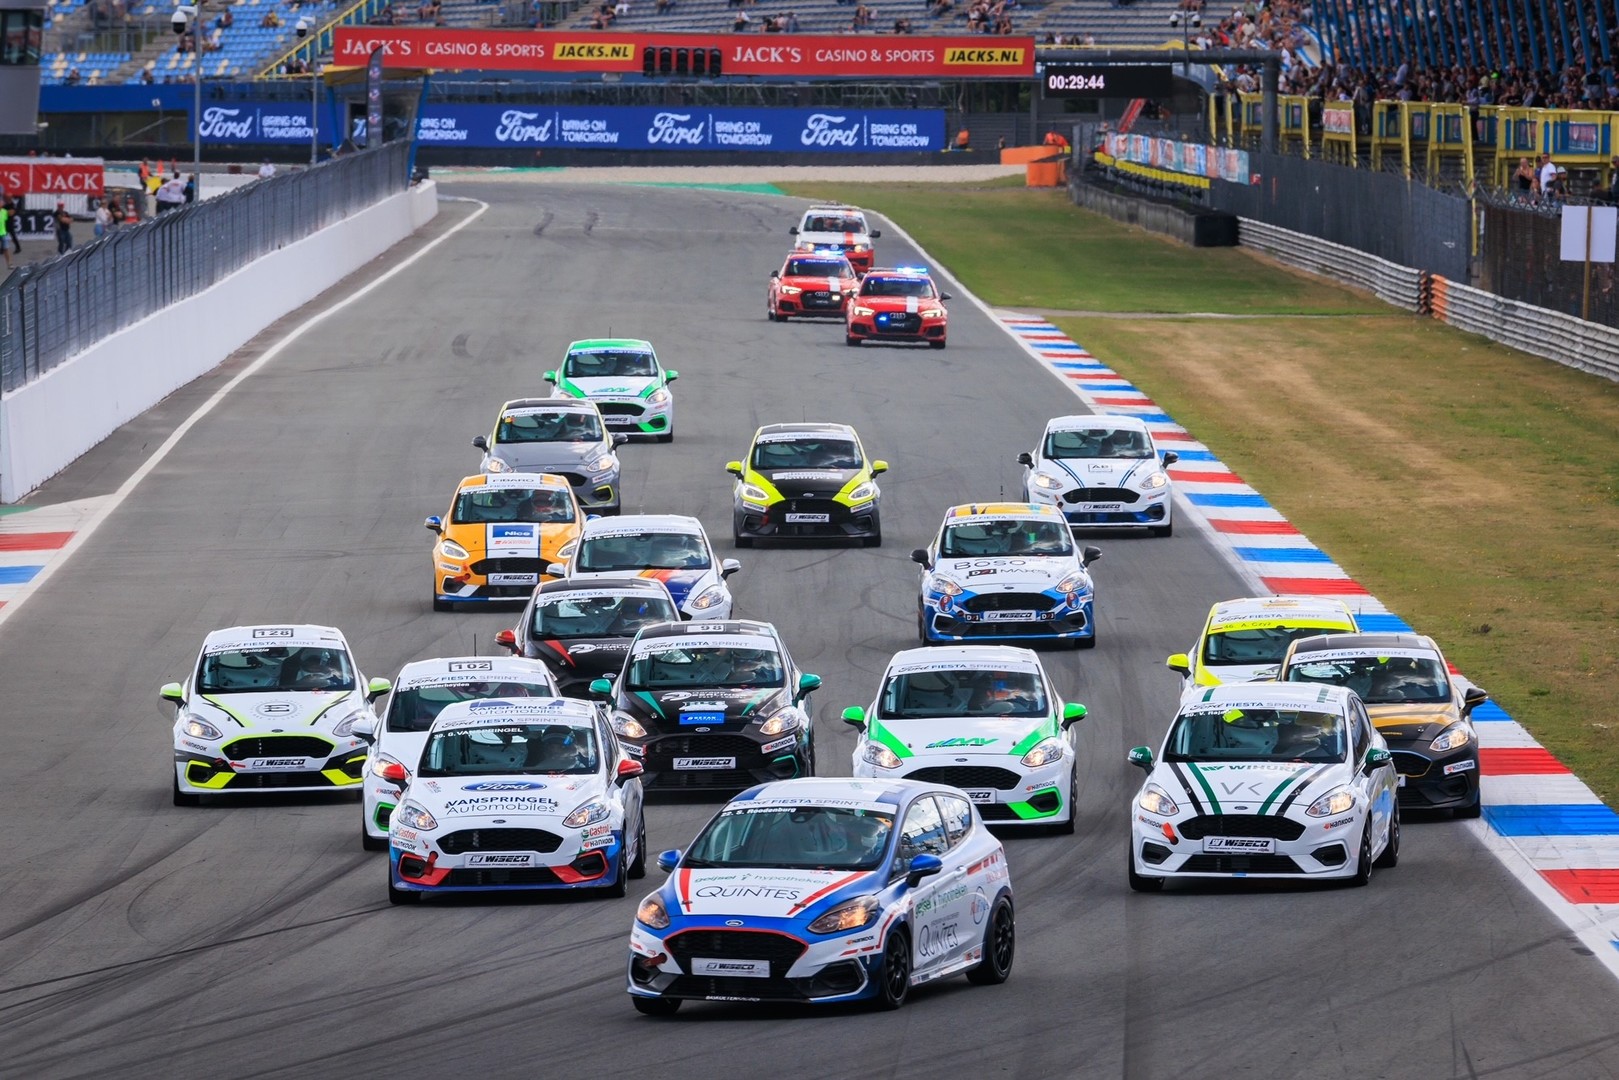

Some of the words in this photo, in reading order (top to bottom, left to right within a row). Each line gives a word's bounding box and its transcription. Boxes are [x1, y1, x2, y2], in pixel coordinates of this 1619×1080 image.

[342, 38, 412, 56] JACK'S
[425, 42, 477, 56] CASINO
[480, 43, 492, 56] &
[495, 43, 545, 58] SPORTS
[558, 44, 630, 59] JACKS.NL
[732, 46, 802, 63] JACK'S
[815, 49, 868, 62] CASINO
[870, 50, 882, 63] &
[885, 50, 935, 64] SPORTS
[948, 50, 1020, 63] JACKS.NL
[1048, 74, 1105, 90] 00:29:44
[199, 107, 252, 139] Ford
[262, 115, 291, 127] BRING
[292, 115, 307, 126] ON
[420, 118, 440, 130] RING
[495, 110, 552, 142] Ford
[562, 119, 587, 131] BRING
[588, 119, 607, 131] ON
[715, 121, 744, 133] BRING
[746, 121, 761, 133] ON
[263, 126, 318, 138] TOMORROW
[417, 129, 468, 141] OMORROW
[647, 113, 704, 145] Ford
[801, 113, 860, 147] Ford
[871, 123, 900, 135] BRING
[902, 123, 918, 135] ON
[562, 131, 619, 143] TOMORROW
[715, 132, 773, 145] TOMORROW
[871, 134, 930, 148] TOMORROW
[41, 172, 99, 190] JACK
[643, 641, 674, 650] Ford
[898, 664, 930, 673] Ford
[408, 676, 439, 685] Ford
[1189, 702, 1224, 711] Ford
[441, 719, 476, 728] Ford
[770, 738, 794, 750] HANKOOK
[695, 758, 732, 766] WISECO
[1229, 764, 1299, 773] WIHURI
[476, 781, 530, 792] Ford
[1031, 780, 1056, 791] HANKOOK
[448, 796, 553, 806] VANSPRINGEL
[814, 799, 862, 807] SPRINT
[446, 802, 556, 815] Automobiles
[1329, 817, 1354, 829] HANKOOK
[398, 829, 418, 841] Castrol
[589, 824, 611, 837] Castrol
[590, 837, 614, 848] HANKOOK
[1224, 839, 1271, 848] WISECO
[485, 855, 530, 863] WISECO
[754, 874, 830, 885] hypotheken
[695, 885, 801, 901] QUINTES
[718, 963, 756, 971] WISECO
